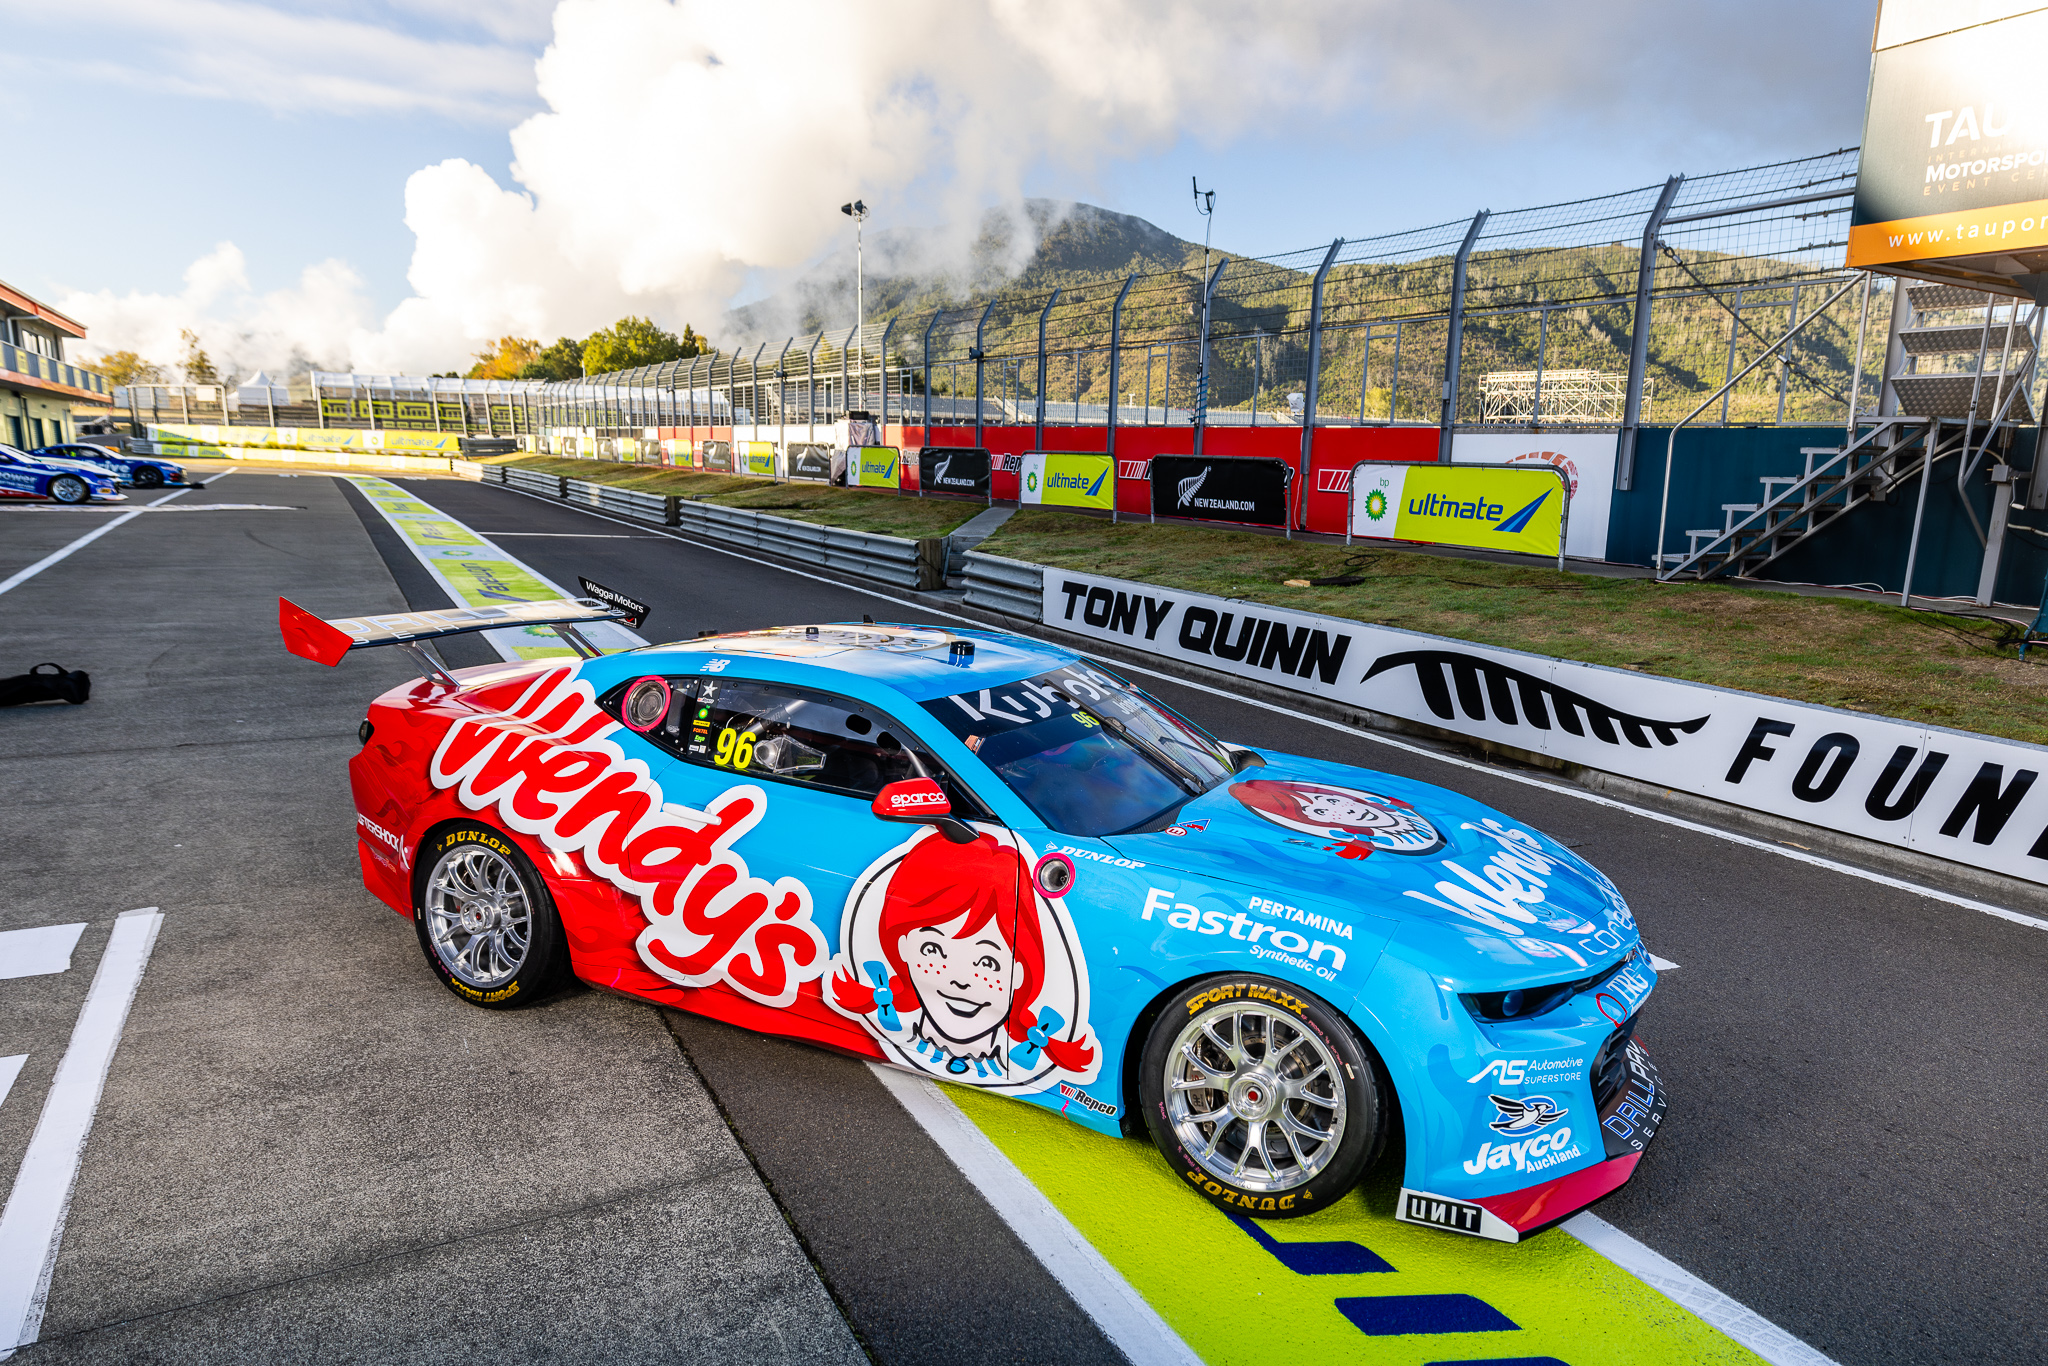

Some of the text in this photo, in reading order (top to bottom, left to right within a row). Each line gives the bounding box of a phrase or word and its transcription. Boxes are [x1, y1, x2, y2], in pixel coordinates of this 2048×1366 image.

[1925, 102, 2014, 148] TAU
[1925, 150, 2048, 183] MOTORSPO
[1923, 177, 1991, 196] EVENT
[862, 461, 885, 474] ultimate
[1047, 472, 1090, 489] ultimate
[1379, 477, 1390, 487] bp
[1408, 493, 1504, 522] ultimate
[586, 581, 644, 613] Wagga Motors
[1061, 580, 2048, 861] TONY QUINN FOUN
[1071, 711, 1101, 729] 96
[714, 728, 756, 769] 96
[891, 792, 946, 808] sparco
[437, 664, 820, 1000] Wendy's
[446, 831, 511, 856] DUNLOP
[1058, 846, 1147, 869] DUNLOP
[1402, 818, 1559, 936] Wendy's
[1141, 887, 1347, 971] Fastron
[1248, 896, 1353, 940] PERTAMINA
[1249, 944, 1337, 982] Synthetic Oil
[1186, 983, 1309, 1015] SPORT MAXX
[1606, 966, 1648, 1005] TRG
[1524, 1072, 1581, 1085] SUPERSTORE
[1528, 1057, 1583, 1071] Automotive
[1073, 1087, 1118, 1116] Repco
[1463, 1127, 1571, 1175] Jayco
[1526, 1144, 1581, 1174] Auckland
[1186, 1170, 1296, 1211] DUNLOP
